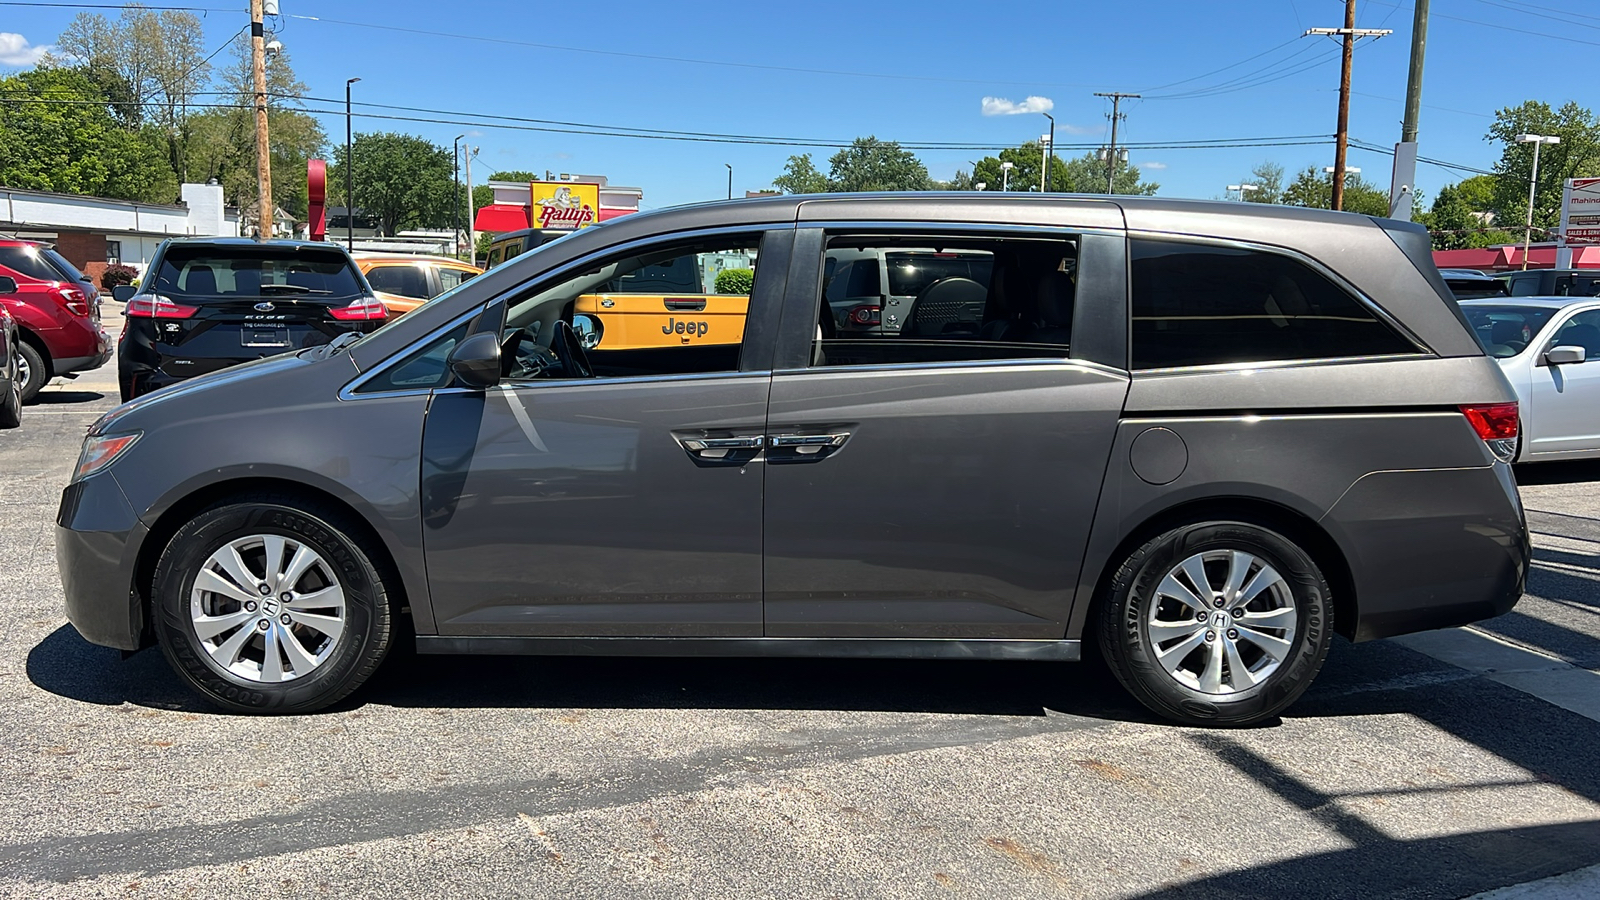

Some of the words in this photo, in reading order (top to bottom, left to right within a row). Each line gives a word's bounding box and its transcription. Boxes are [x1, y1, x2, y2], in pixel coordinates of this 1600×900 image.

[539, 204, 594, 228] Rally's
[662, 317, 708, 338] Jeep
[273, 513, 361, 581] ASSURANCE
